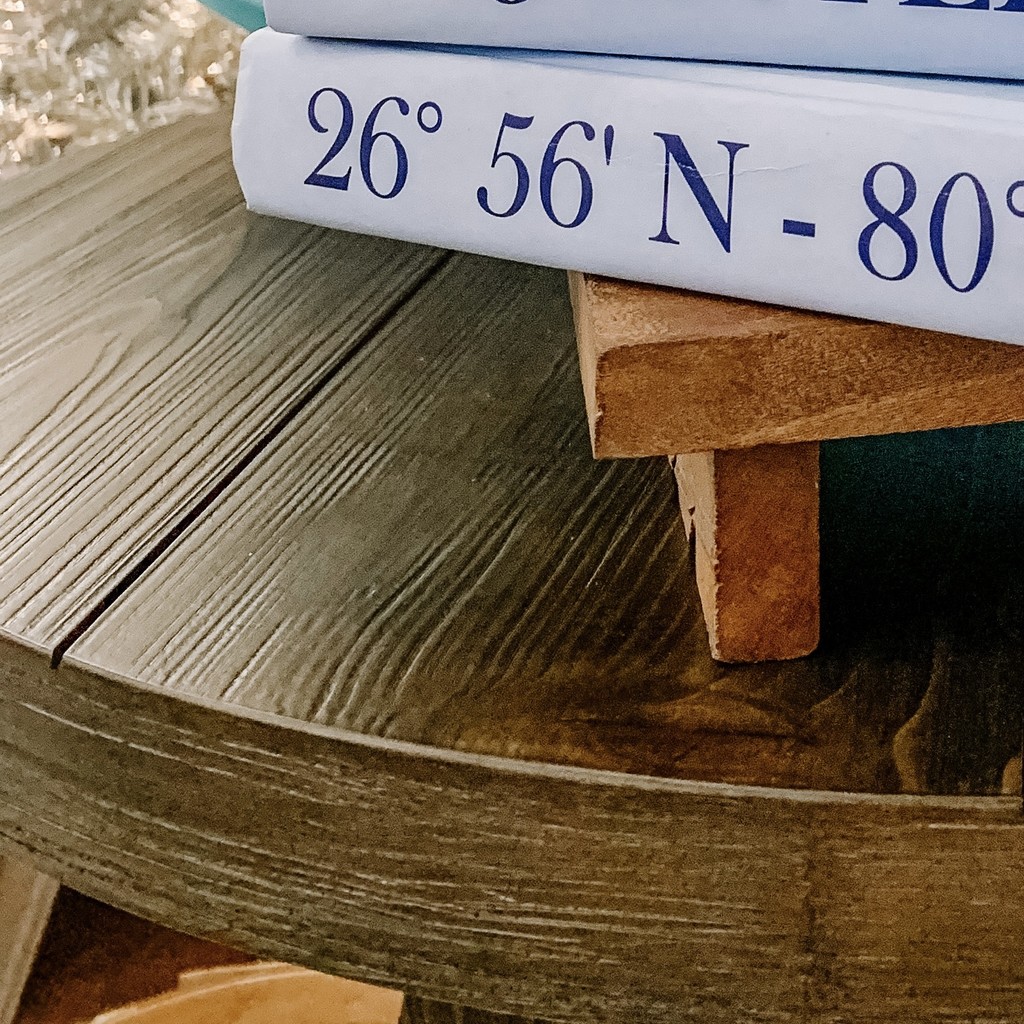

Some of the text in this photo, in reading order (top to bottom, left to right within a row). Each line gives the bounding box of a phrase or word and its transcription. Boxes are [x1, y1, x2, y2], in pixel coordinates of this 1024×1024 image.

[303, 87, 443, 200] 26°
[476, 112, 615, 229] 56'
[648, 131, 750, 254] N
[782, 218, 816, 238] -
